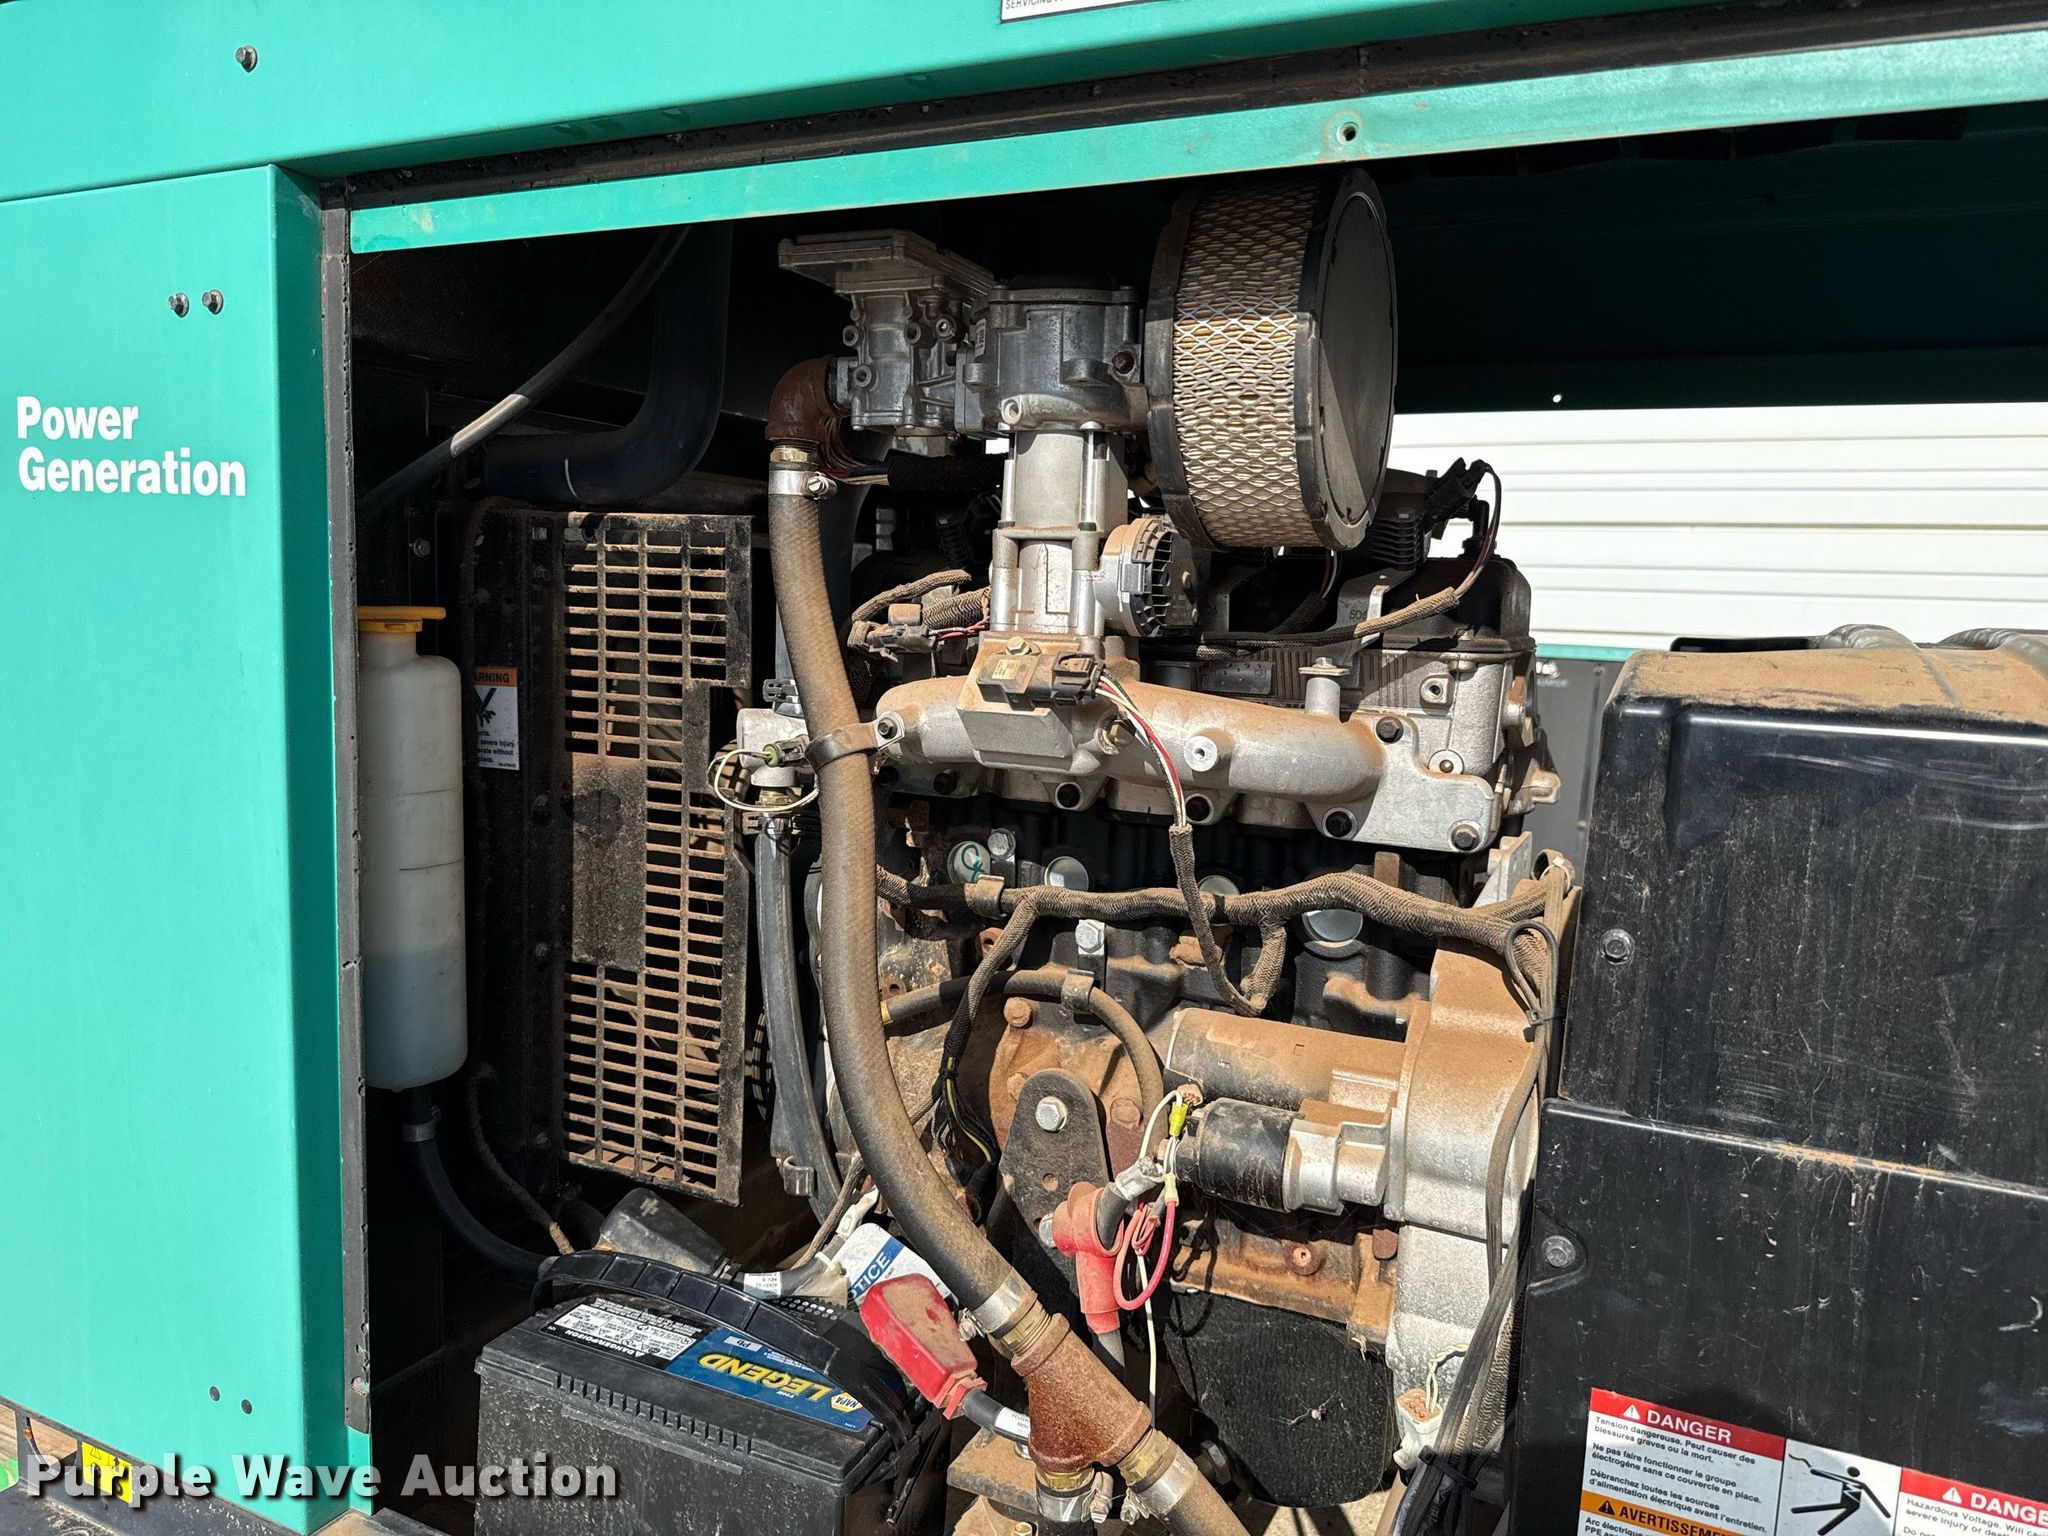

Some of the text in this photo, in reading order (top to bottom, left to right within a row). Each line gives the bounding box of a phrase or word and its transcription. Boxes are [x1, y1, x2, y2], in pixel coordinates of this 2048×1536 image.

[16, 396, 139, 441] Power
[18, 446, 246, 497] Generation
[698, 1352, 834, 1402] LEGEND
[776, 1390, 795, 1399] THE
[836, 1395, 858, 1409] NAPA
[1595, 1425, 1713, 1463] blessures graves ou la mort.
[1596, 1416, 1756, 1464] Tension dangereuse. Peut causer des
[1646, 1409, 1732, 1443] DANGER
[1592, 1442, 1737, 1487] Ne pas faire fonctionner le groupe
[1590, 1468, 1720, 1511] Débranchez toutes les sources
[1642, 1466, 1663, 1477] sans
[1665, 1472, 1675, 1480] ce
[1677, 1475, 1720, 1492] couvercle
[1722, 1488, 1733, 1496] en
[1735, 1491, 1761, 1504] place.
[1586, 1517, 1600, 1527] Arc
[1589, 1478, 1767, 1533] d'alimentation électrique avant l'entretien.
[1620, 1506, 1729, 1536] AVERTISSEM
[1906, 1498, 1959, 1518] Hazardous
[2005, 1523, 2024, 1535] Will
[1906, 1509, 1938, 1521] severe
[1940, 1517, 1969, 1531] injury
[1585, 1525, 1602, 1536] PPE
[1903, 1526, 1917, 1536] Do
